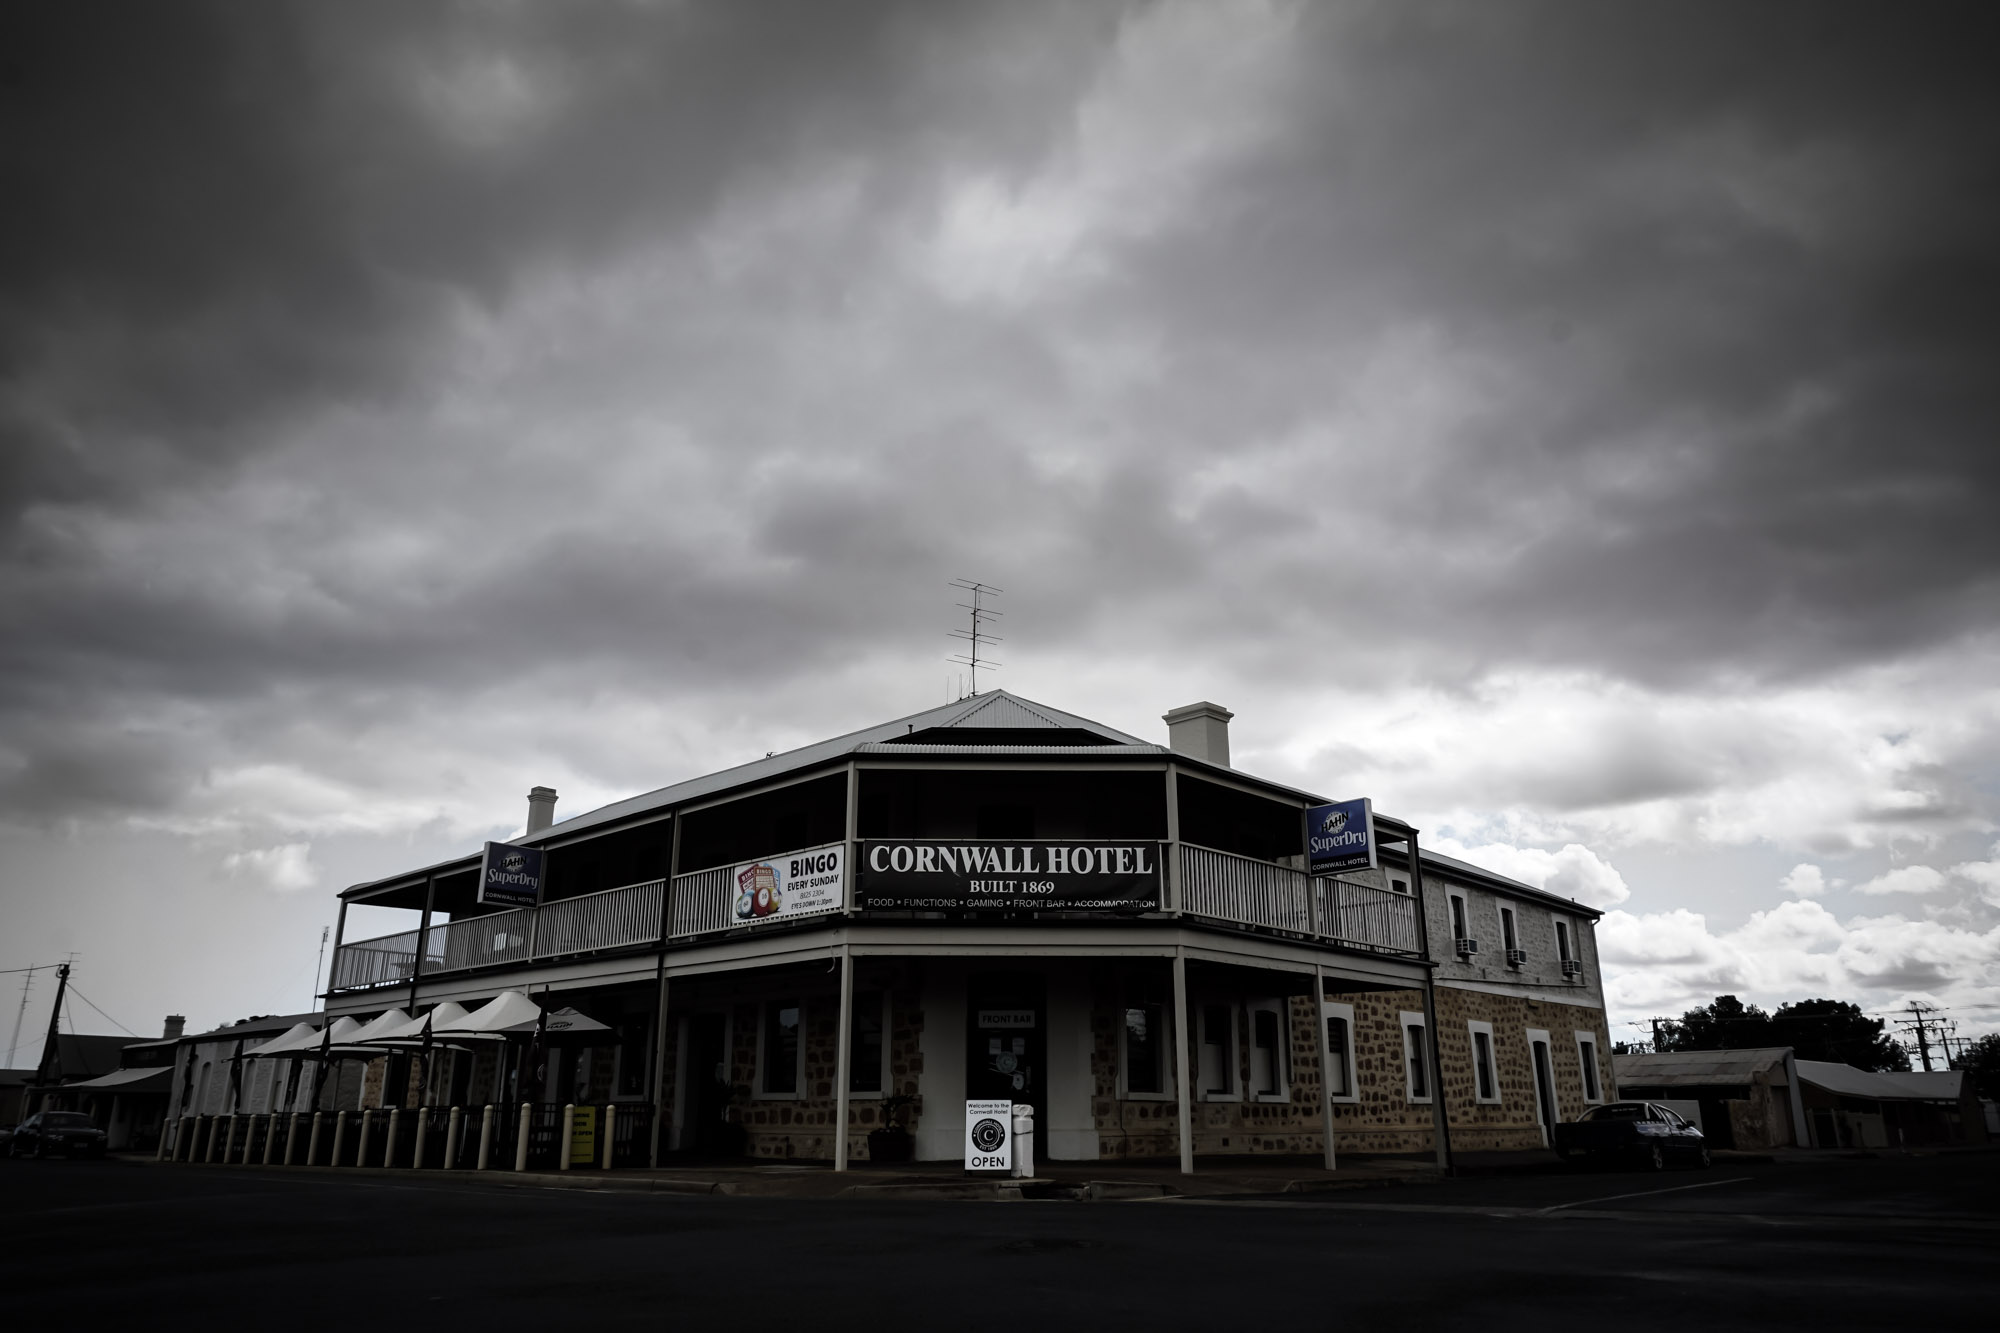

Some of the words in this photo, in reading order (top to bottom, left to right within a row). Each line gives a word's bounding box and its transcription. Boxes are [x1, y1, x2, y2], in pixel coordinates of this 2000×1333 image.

[1321, 811, 1349, 833] HAHN
[1310, 830, 1367, 854] SuperDry
[500, 856, 527, 868] HAHN
[791, 853, 837, 878] BINGO
[869, 845, 1041, 874] CORNWALL
[1046, 846, 1153, 875] HOTEL
[1312, 860, 1347, 871] CORNWALL
[1347, 857, 1369, 866] HOTEL
[487, 868, 538, 890] SuperDry
[787, 880, 808, 891] EVERY
[810, 874, 839, 887] SUNDAY
[969, 880, 1018, 894] BUILT
[1021, 880, 1055, 894] 1869
[485, 892, 516, 901] CORNWALL
[867, 898, 895, 907] FOOD
[903, 898, 957, 908] FUNCTIONS
[966, 898, 1004, 908] GAMING
[1013, 899, 1044, 908] FRONT
[1047, 899, 1066, 908] BAR
[1074, 899, 1156, 909] ACCOMMODATION
[982, 1015, 1011, 1023] FRONT
[1013, 1015, 1031, 1023] BAR
[983, 1129, 994, 1141] C
[971, 1156, 1005, 1167] OPEN
